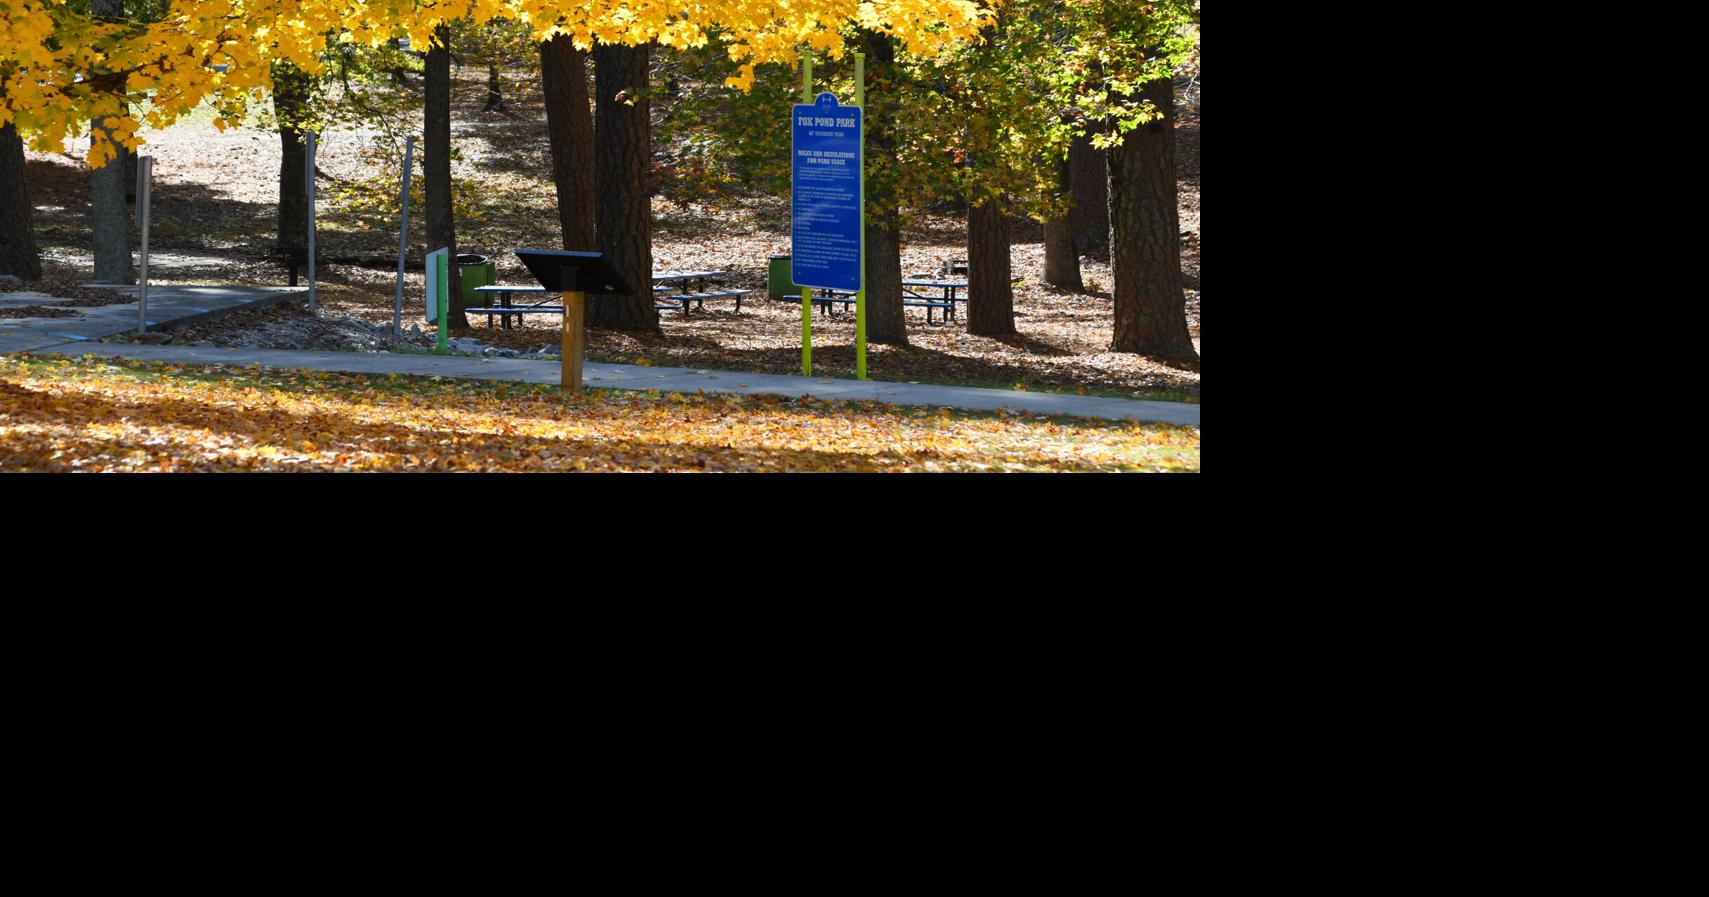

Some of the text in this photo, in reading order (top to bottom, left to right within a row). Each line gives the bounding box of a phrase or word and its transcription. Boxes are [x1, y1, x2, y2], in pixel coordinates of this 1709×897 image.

[798, 117, 855, 128] FOX POND PARK
